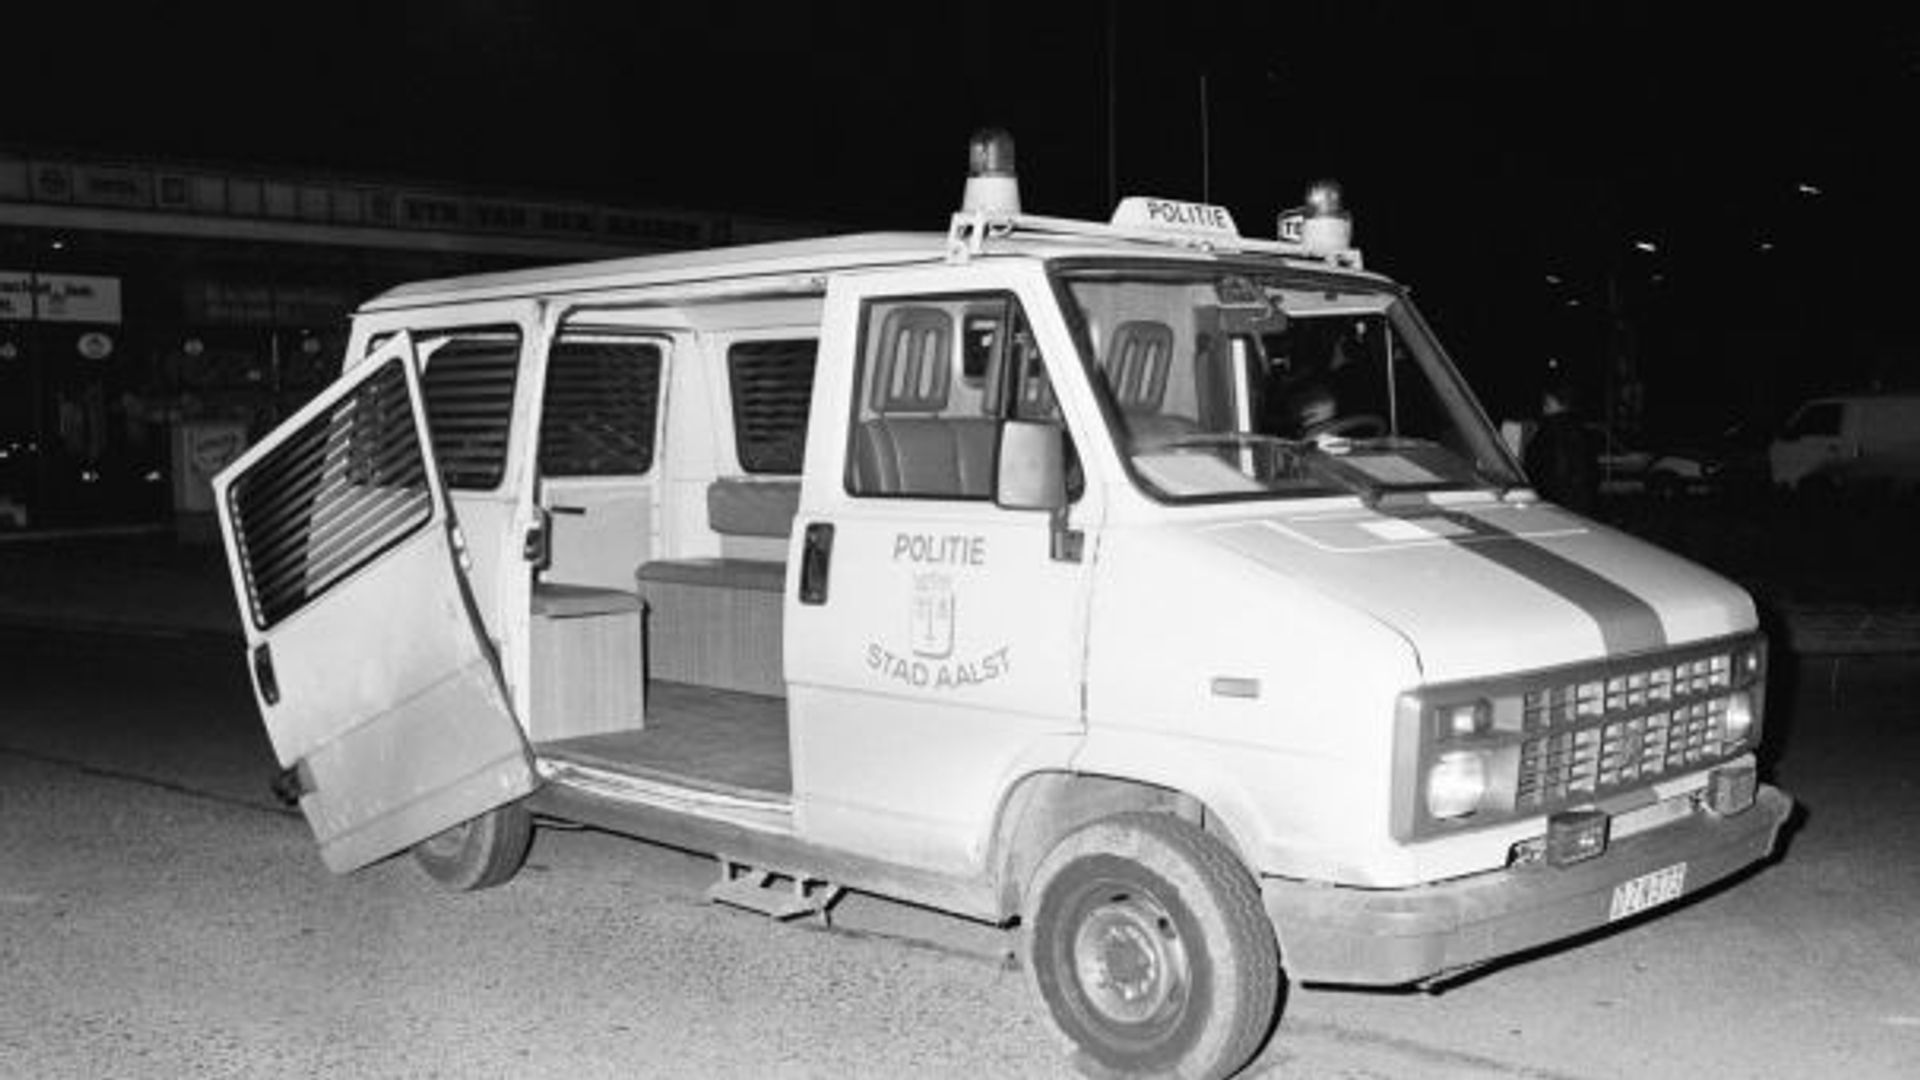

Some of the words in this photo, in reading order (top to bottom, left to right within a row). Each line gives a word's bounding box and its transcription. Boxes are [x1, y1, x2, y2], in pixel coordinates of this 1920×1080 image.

[1147, 202, 1228, 229] POLITIE
[893, 533, 985, 565] POLITIE
[866, 643, 929, 687] STAD
[934, 646, 1010, 688] AALST
